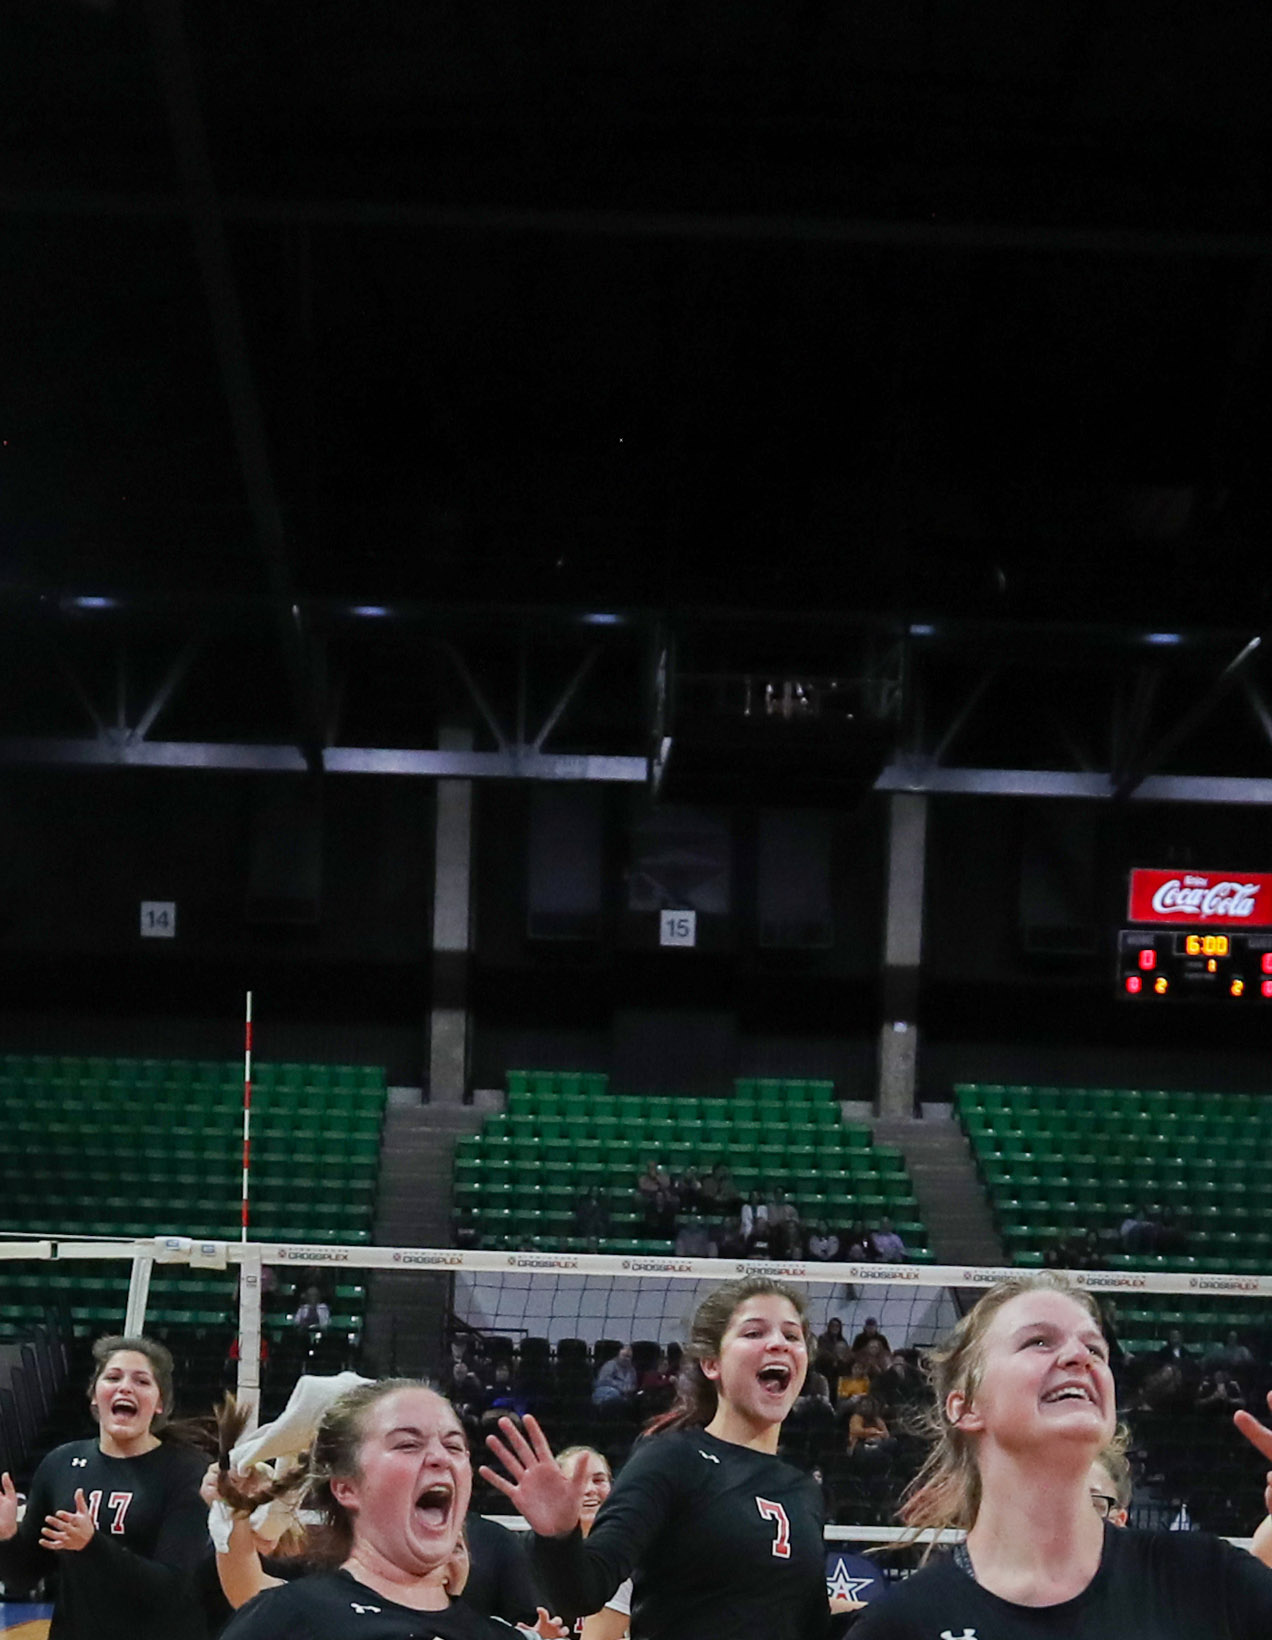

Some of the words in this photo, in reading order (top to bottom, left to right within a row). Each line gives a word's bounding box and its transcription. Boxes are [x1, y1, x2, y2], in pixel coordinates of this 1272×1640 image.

[146, 909, 169, 929] 14
[666, 918, 690, 938] 15
[1185, 934, 1229, 957] 6:00
[88, 1489, 133, 1535] 17
[755, 1496, 791, 1559] 7
